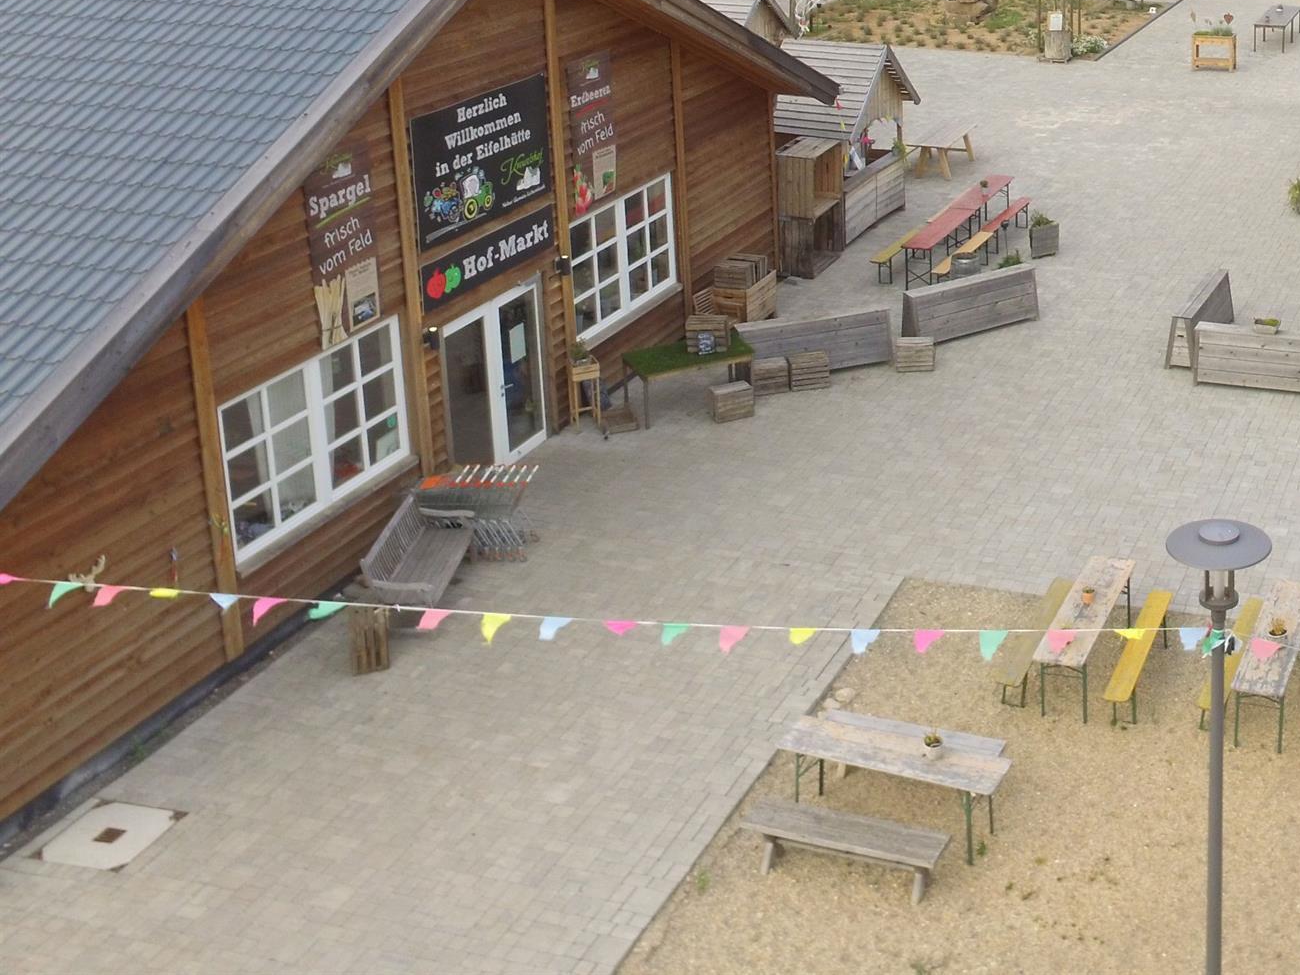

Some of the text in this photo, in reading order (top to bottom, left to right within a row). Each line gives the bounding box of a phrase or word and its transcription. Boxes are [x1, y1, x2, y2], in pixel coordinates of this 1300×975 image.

[456, 92, 508, 123] Herzlich
[570, 85, 612, 108] Erdbeeren
[444, 111, 522, 150] Willkommen
[577, 137, 595, 156] vom
[595, 123, 615, 143] Feld
[580, 111, 606, 135] frisch
[435, 129, 532, 178] in der Eifelhütte
[308, 174, 372, 219] Spargel
[324, 216, 361, 249] frisch
[462, 219, 549, 280] Hof-Markt
[319, 249, 347, 275] vom
[348, 228, 373, 256] Feld
